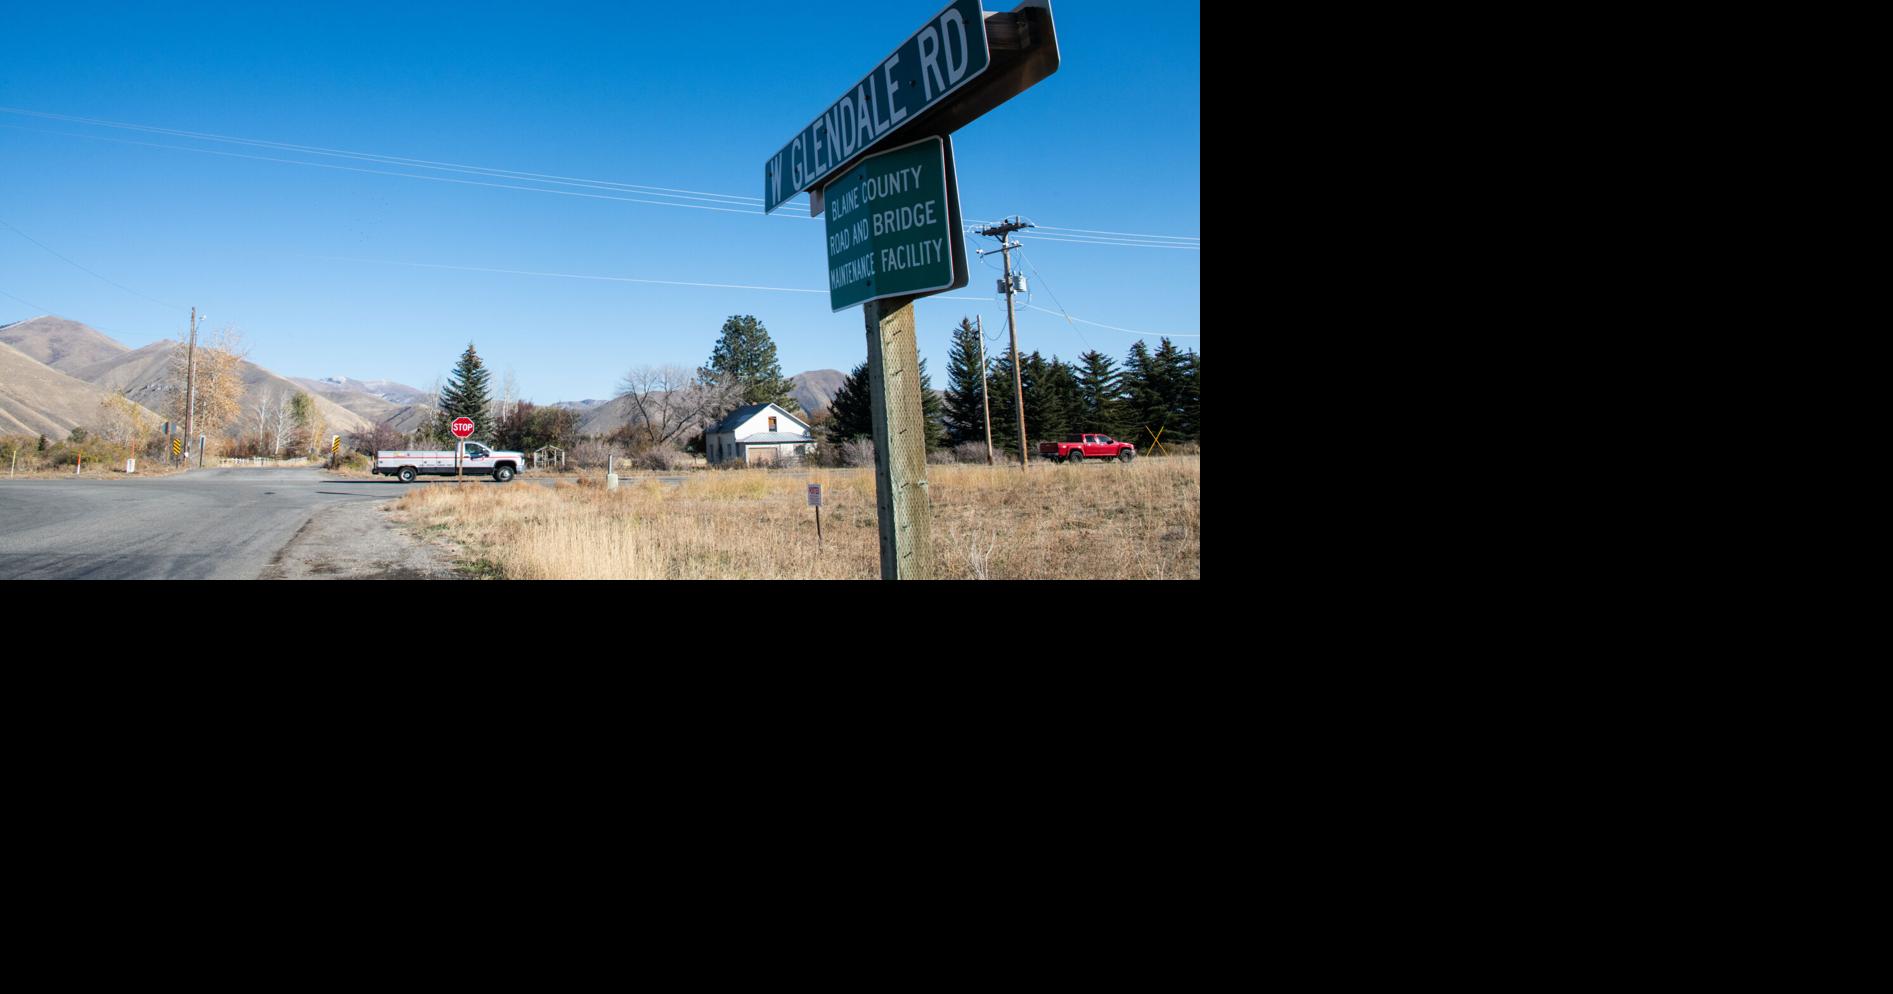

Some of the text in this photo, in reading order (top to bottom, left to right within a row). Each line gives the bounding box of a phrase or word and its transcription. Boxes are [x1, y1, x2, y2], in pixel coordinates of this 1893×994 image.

[769, 8, 969, 206] W GLENDALE RD
[832, 165, 924, 221] BLAINE COUNTY
[830, 200, 937, 257] ROAD AND BRIDGE
[830, 238, 943, 289] MAINTENANCE FACILITY
[453, 423, 473, 432] STOP
